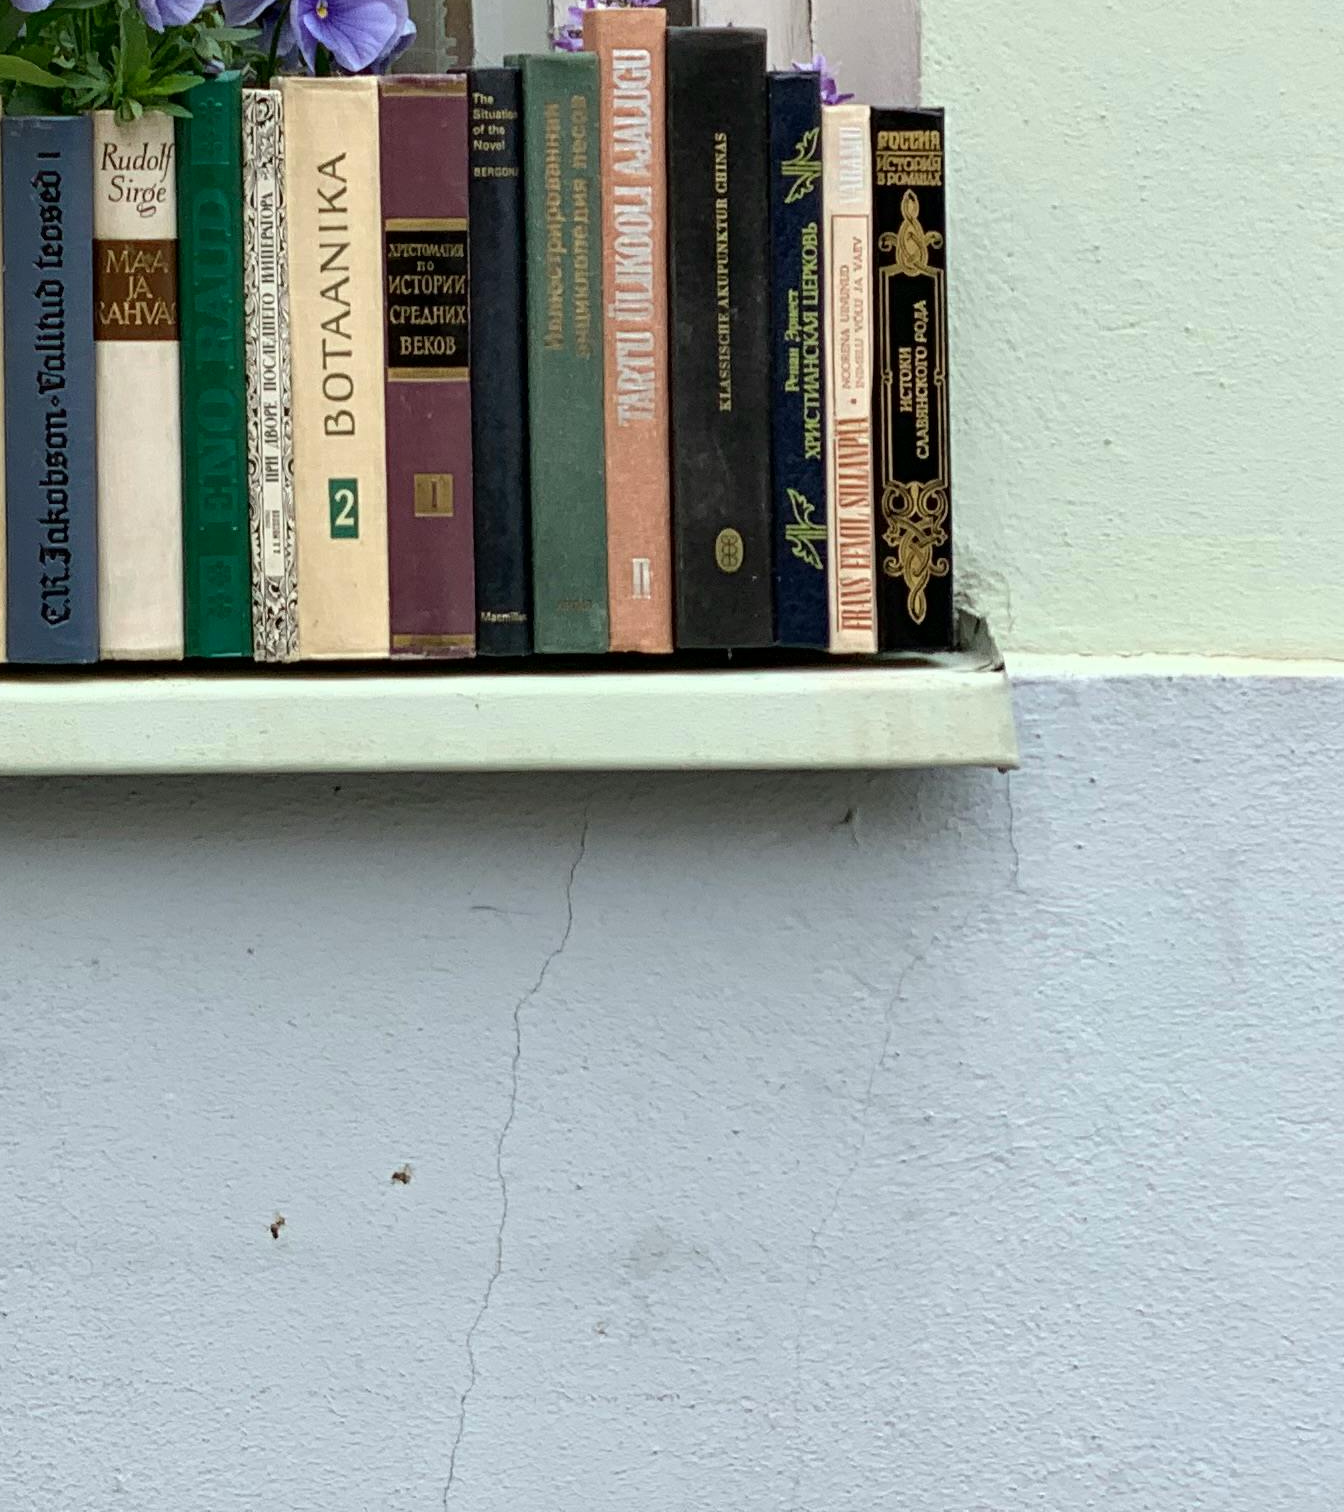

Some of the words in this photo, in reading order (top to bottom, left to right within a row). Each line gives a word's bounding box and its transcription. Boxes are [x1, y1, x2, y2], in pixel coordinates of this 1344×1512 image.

[472, 92, 495, 105] The
[611, 48, 653, 177] AJALUGU
[472, 124, 484, 136] of
[488, 124, 505, 136] the
[473, 139, 505, 151] Novel
[877, 130, 941, 150] РОССИЯ
[101, 142, 175, 183] Rudolf
[108, 174, 167, 219] Sirge
[31, 169, 64, 270] teosed
[105, 249, 169, 274] MAA
[851, 236, 864, 271] VAEV
[316, 152, 356, 437] BOTAANIKA
[388, 275, 466, 295] ИСТОРИИ
[838, 264, 851, 324] UINUNUD
[389, 305, 467, 325] СРЕДНИХ
[399, 335, 457, 356] ВЕКОВ
[838, 328, 851, 389] NOORENA
[853, 333, 866, 389] INIMELU
[613, 330, 656, 428] TARTU
[263, 403, 279, 449] ДВОРЕ
[265, 455, 280, 484] ПРИ
[334, 488, 356, 527] 2
